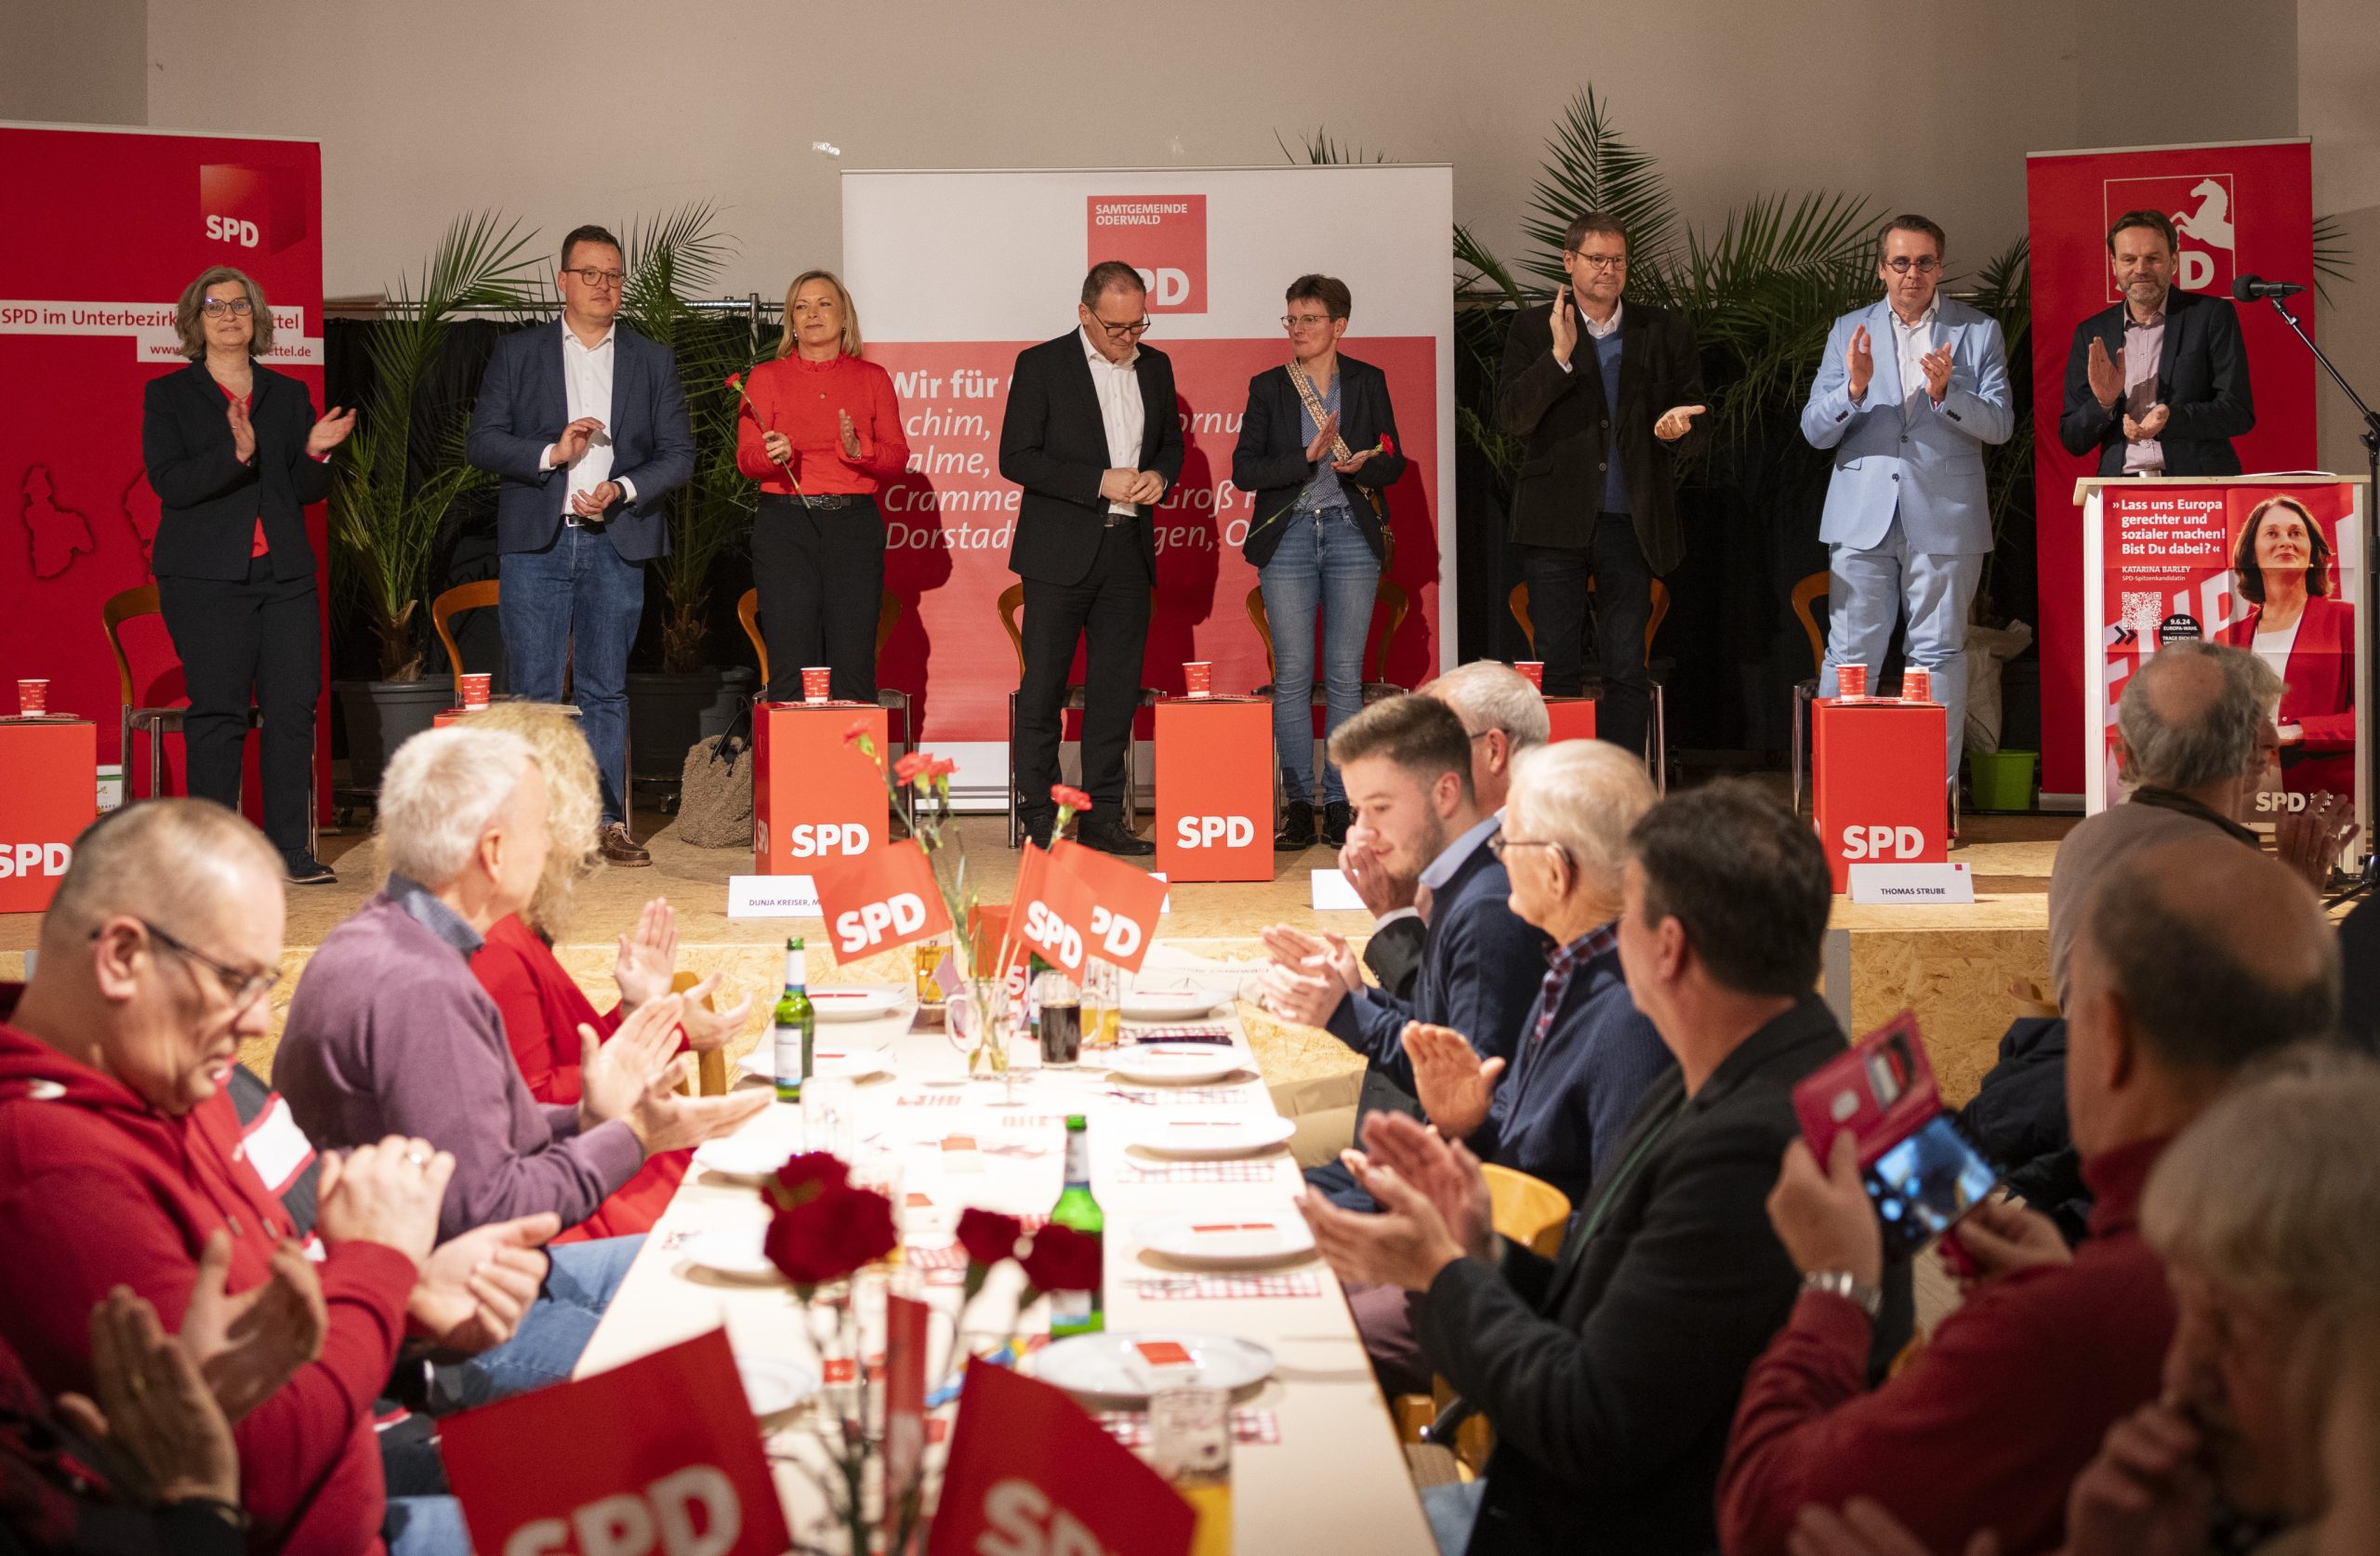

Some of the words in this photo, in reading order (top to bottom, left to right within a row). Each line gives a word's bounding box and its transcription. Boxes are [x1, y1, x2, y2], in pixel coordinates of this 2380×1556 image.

[1095, 204, 1188, 215] SAMTGEMEINDE
[1095, 215, 1161, 226] ODERWALD
[205, 214, 259, 248] SPD
[1, 309, 38, 325] SPD
[44, 310, 66, 325] im
[73, 310, 178, 327] Unterbezirk
[893, 369, 943, 399] Wir
[950, 369, 999, 399] für
[906, 407, 991, 442] chim,
[906, 444, 990, 480] alme,
[2122, 513, 2181, 528] gerechter
[2183, 513, 2208, 524] und
[2150, 501, 2175, 510] uns
[2177, 499, 2223, 513] Europa
[885, 520, 1016, 550] Dorstad
[2122, 528, 2169, 540] sozialer
[2172, 528, 2226, 540] machen!
[2122, 543, 2146, 555] Bist
[2148, 543, 2166, 555] Du
[2122, 565, 2161, 574] KATARINA
[2162, 565, 2191, 574] BARLEY
[2254, 791, 2306, 812] SPD
[790, 823, 870, 858] SPD
[1176, 815, 1255, 849] SPD
[1841, 824, 1924, 860] SPD
[0, 842, 73, 878] SPD
[836, 891, 927, 954] SPD
[1023, 900, 1083, 969] SPD
